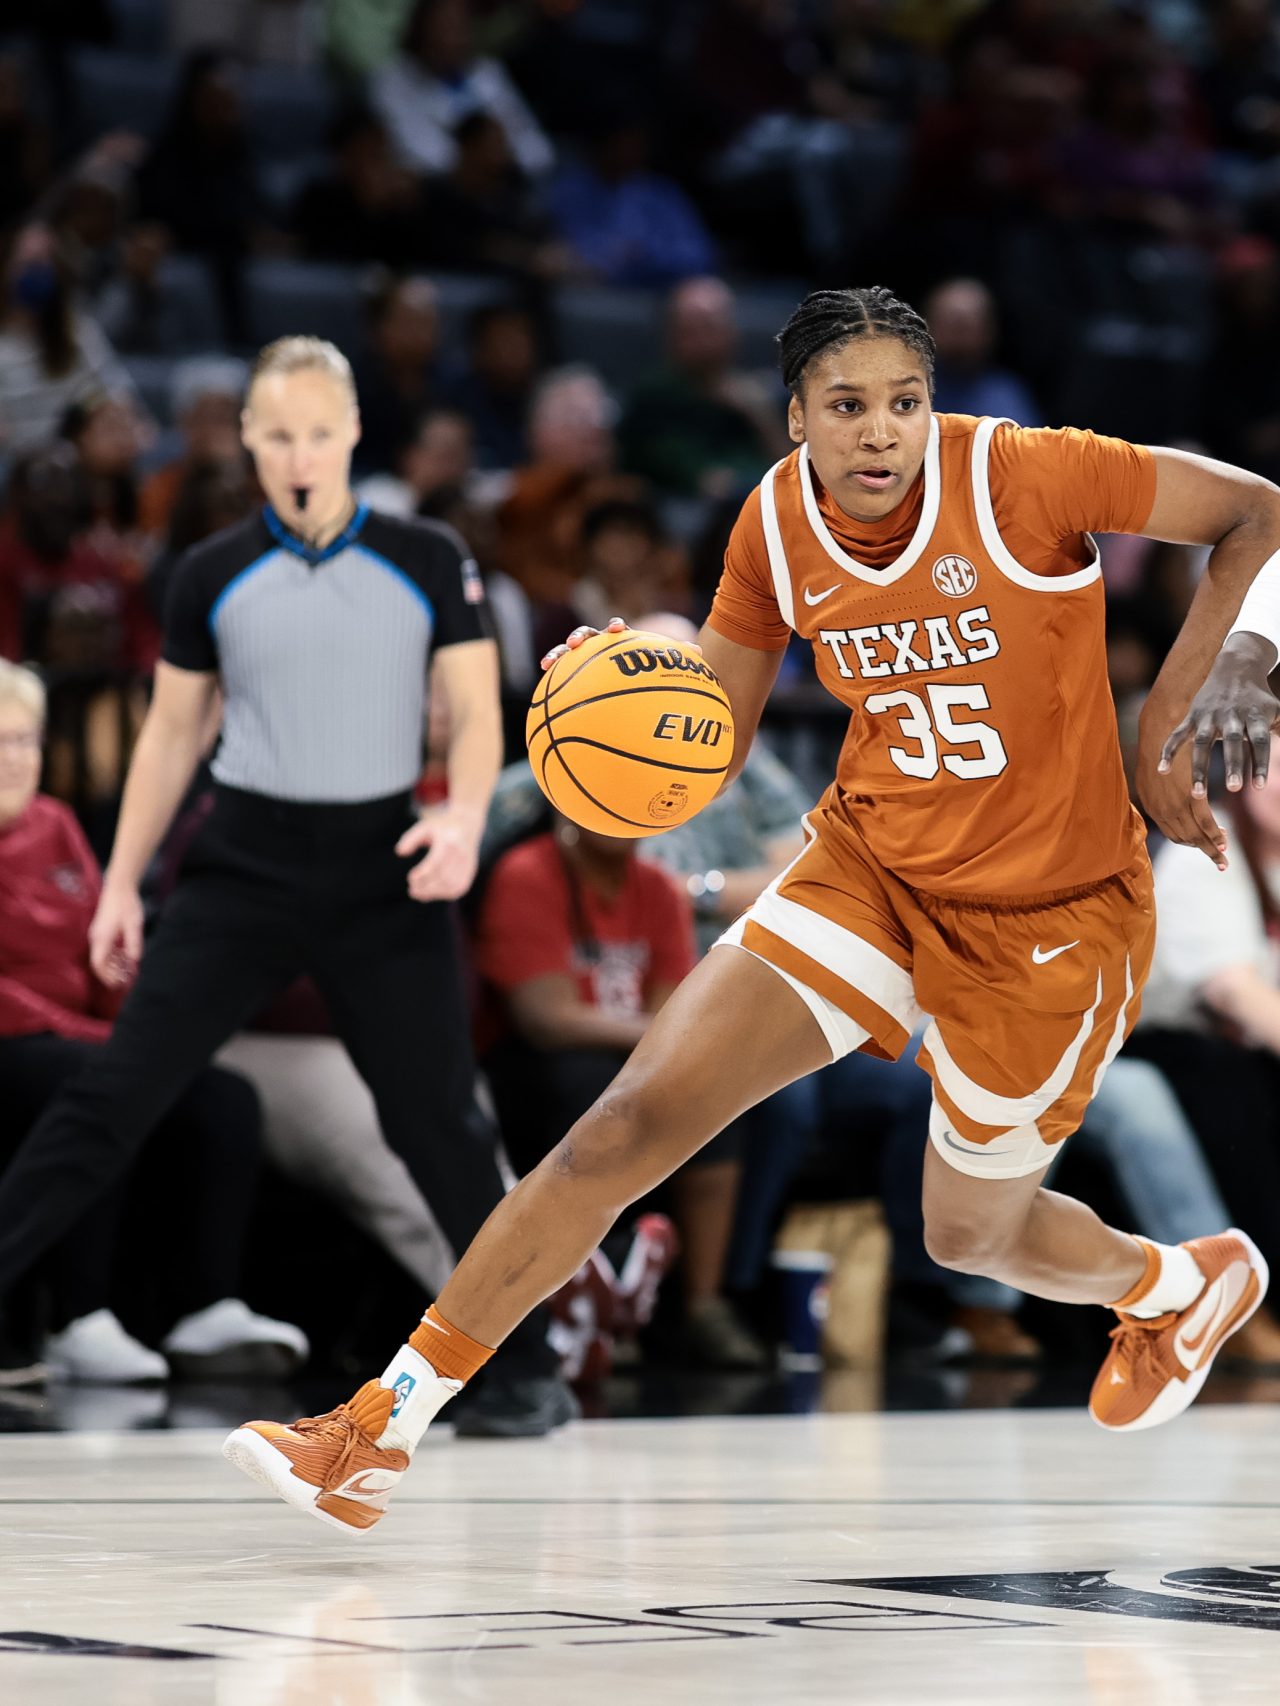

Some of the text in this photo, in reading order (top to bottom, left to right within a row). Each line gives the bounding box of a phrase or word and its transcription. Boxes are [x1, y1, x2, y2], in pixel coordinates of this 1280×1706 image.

[934, 556, 975, 595] SEC
[818, 605, 1001, 679] TEXAS
[653, 713, 722, 746] EVO
[863, 683, 1009, 781] 35
